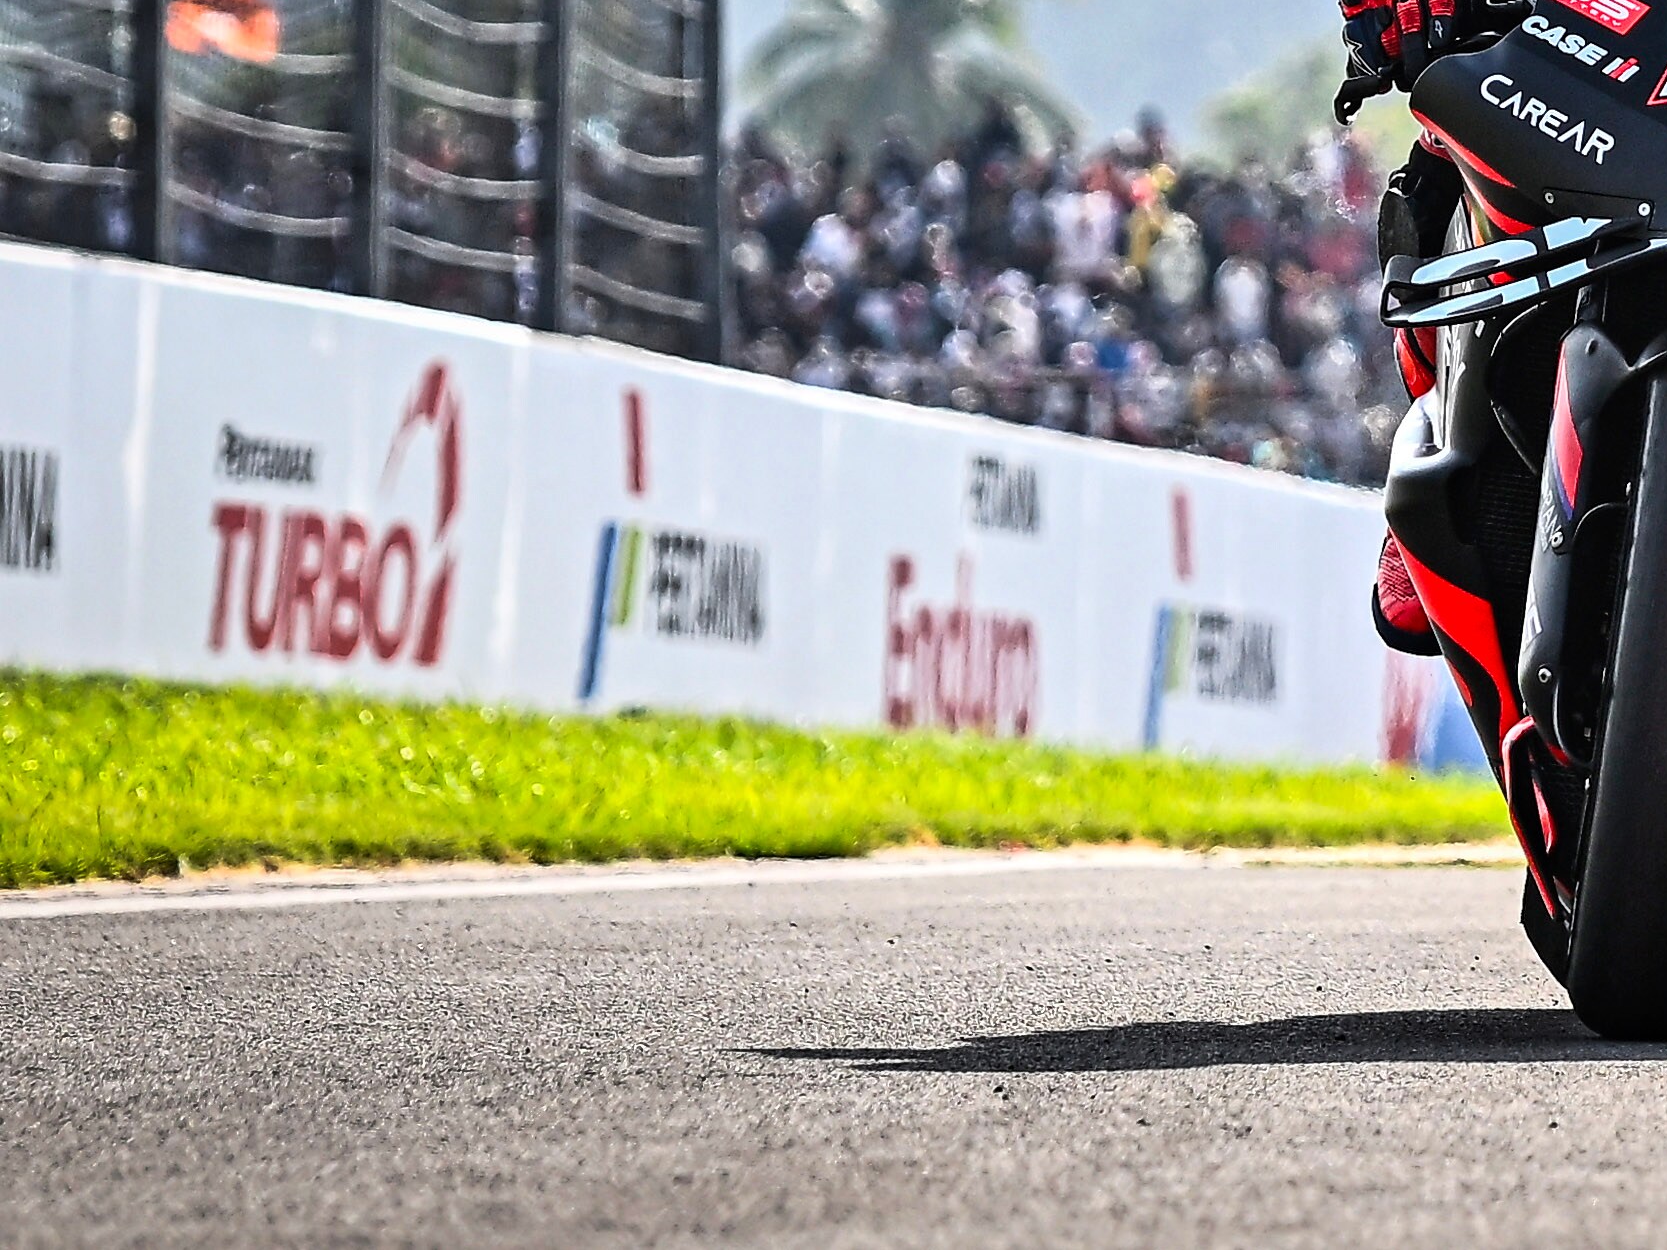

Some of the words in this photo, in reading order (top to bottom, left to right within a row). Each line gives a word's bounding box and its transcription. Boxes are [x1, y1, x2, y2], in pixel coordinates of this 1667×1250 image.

[1522, 15, 1609, 66] CASE
[1480, 74, 1616, 166] CAREAR
[209, 502, 417, 662] TURBO
